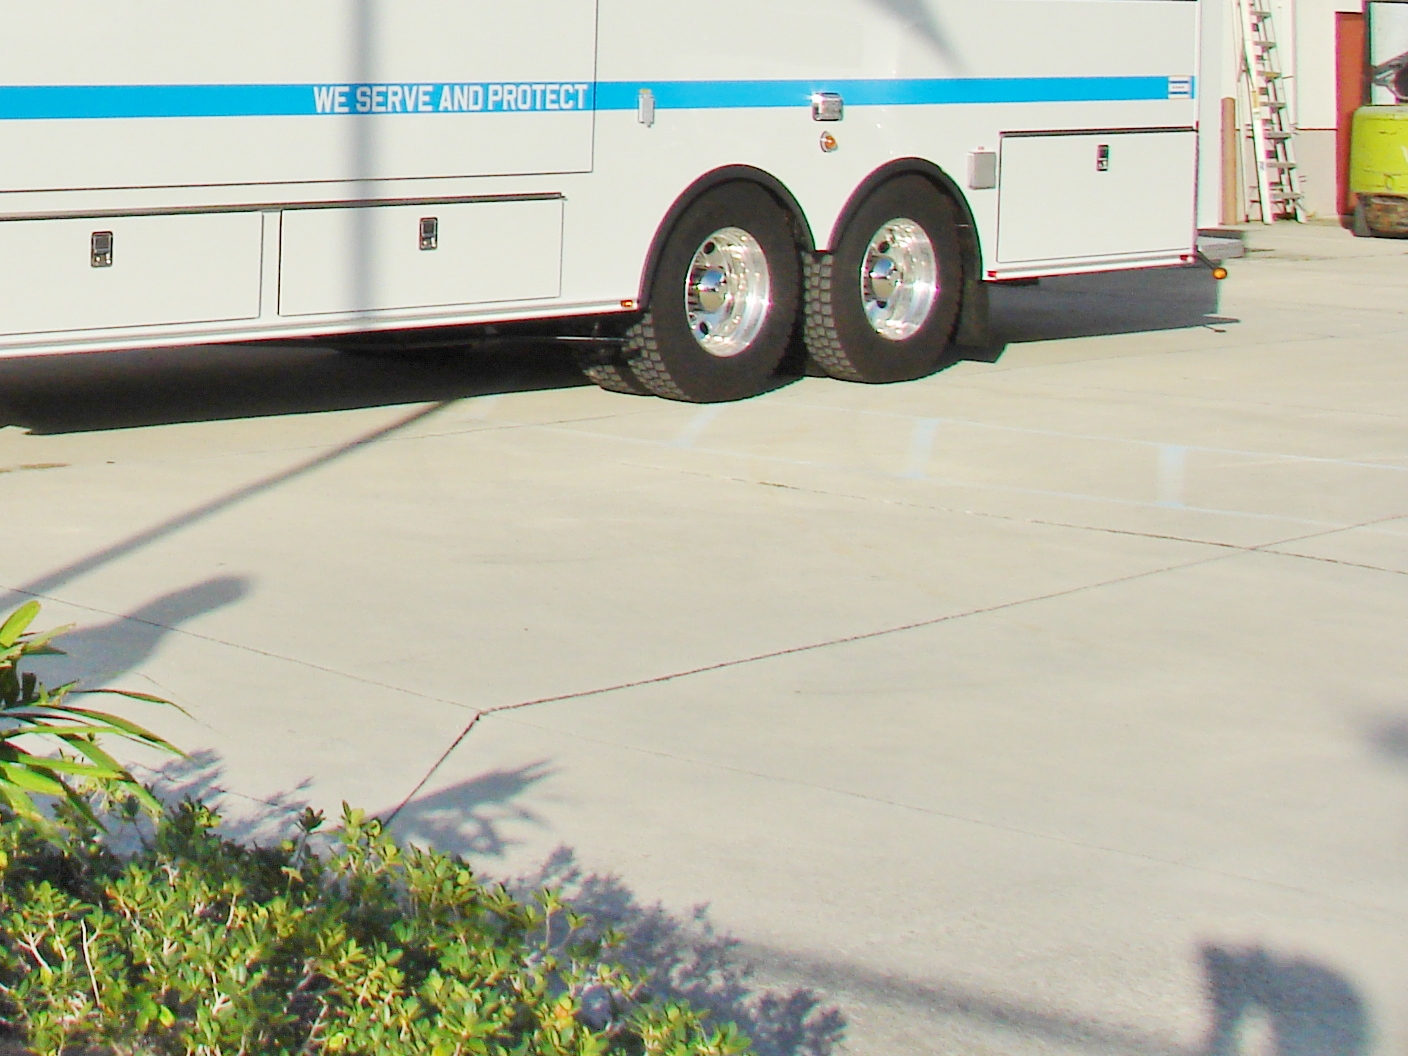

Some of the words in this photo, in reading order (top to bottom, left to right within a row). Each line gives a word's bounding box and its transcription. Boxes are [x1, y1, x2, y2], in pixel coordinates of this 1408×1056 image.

[313, 86, 350, 113] WE
[355, 85, 434, 112] SERVE
[438, 84, 483, 112] AND
[487, 83, 588, 111] PROTECT
